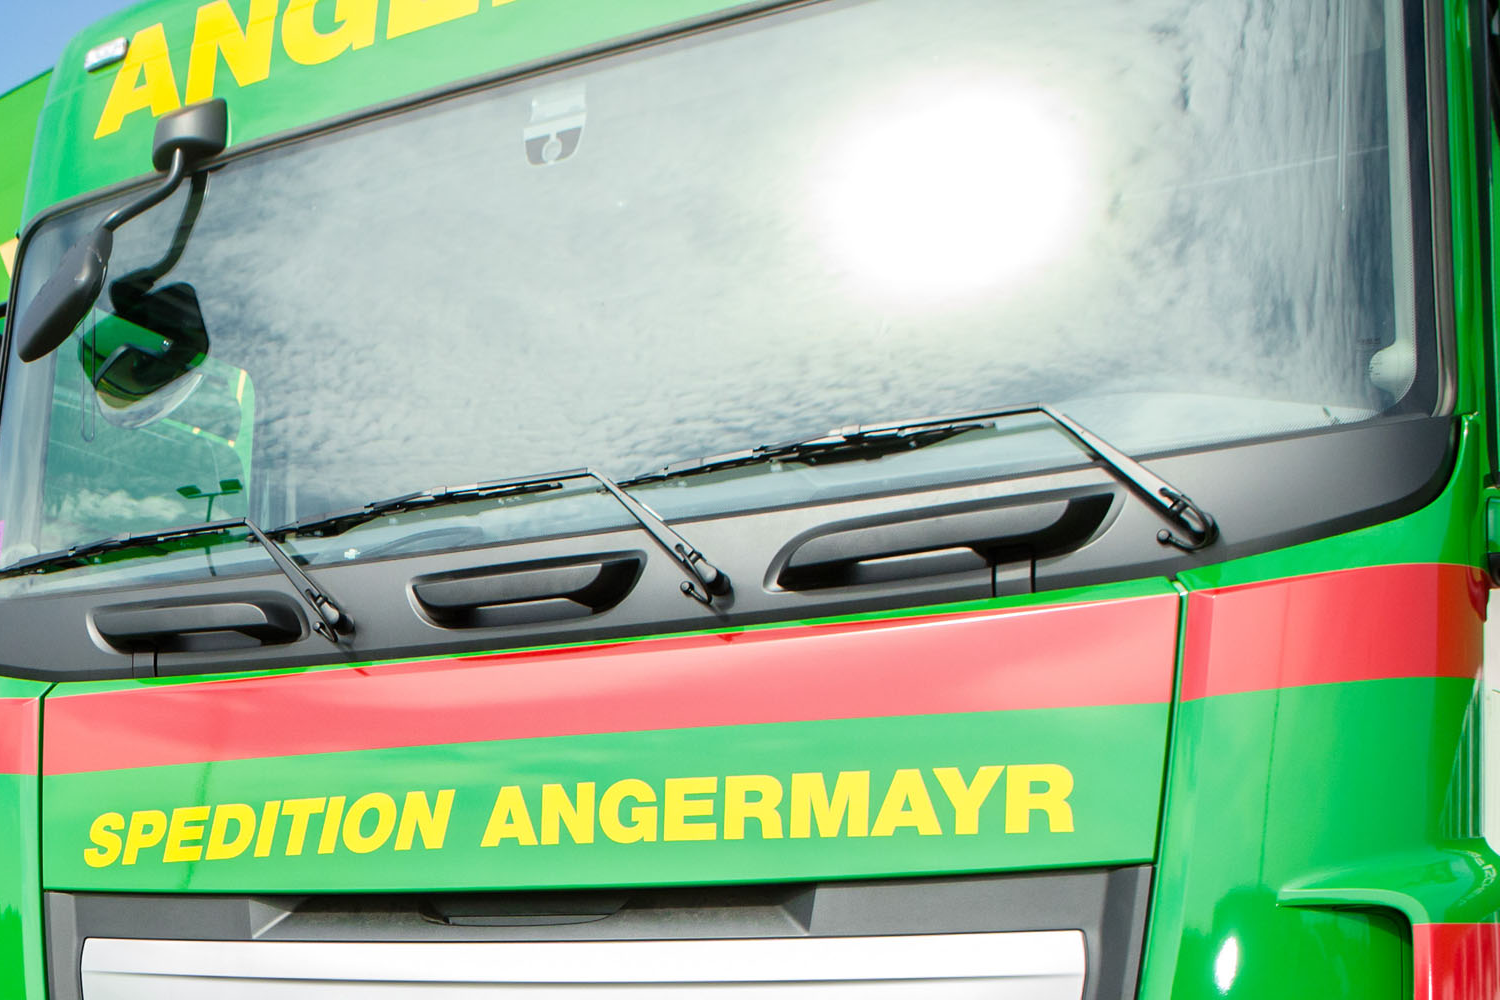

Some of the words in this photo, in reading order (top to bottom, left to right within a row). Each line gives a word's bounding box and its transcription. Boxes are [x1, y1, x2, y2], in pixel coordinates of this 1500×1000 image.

[94, 0, 515, 140] ANG
[83, 786, 456, 868] SPEDITION
[480, 763, 1075, 847] ANGERMAYR
